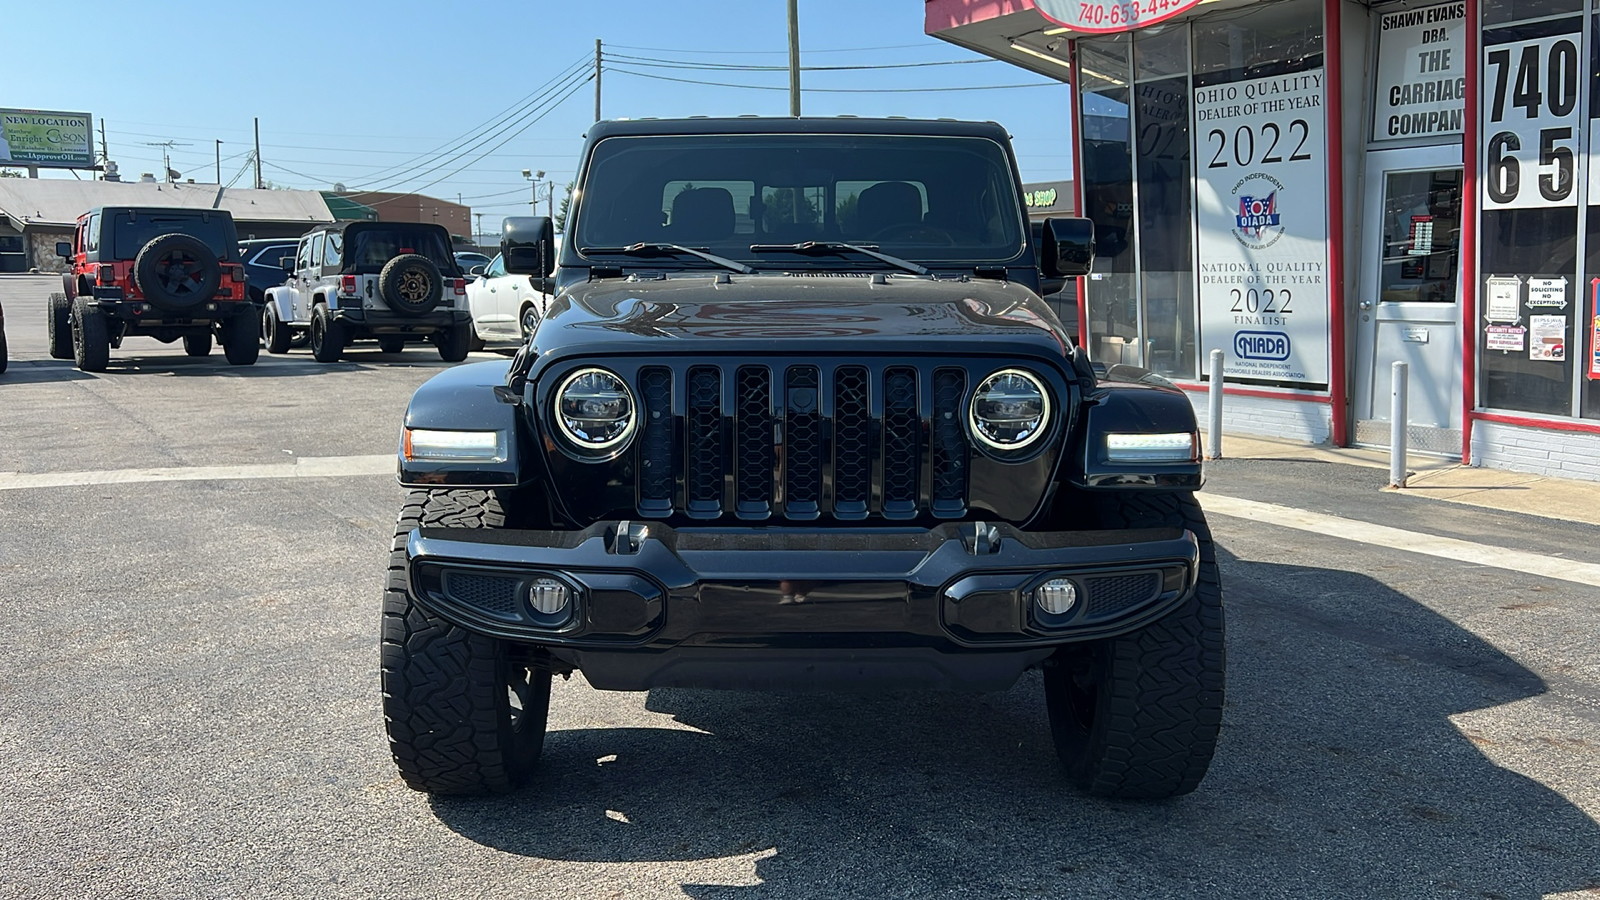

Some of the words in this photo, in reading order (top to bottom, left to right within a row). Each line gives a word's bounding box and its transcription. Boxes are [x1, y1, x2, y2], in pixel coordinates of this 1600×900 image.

[1382, 10, 1424, 31] SHAWN
[1422, 27, 1449, 44] DBA.
[1418, 48, 1451, 73] THE
[1196, 86, 1238, 105] OHIO
[1245, 74, 1322, 99] QUALITY
[1488, 39, 1578, 123] 740
[1198, 104, 1241, 121] DEALER
[1243, 102, 1259, 116] OF
[1261, 99, 1285, 113] THE
[1287, 94, 1320, 110] YEAR
[6, 116, 29, 124] NEW
[32, 117, 85, 127] LOCATION
[1387, 108, 1466, 136] COMPAN
[10, 134, 43, 144] Enright
[1208, 119, 1311, 168] 2022
[1231, 179, 1245, 195] OHIO
[1244, 172, 1285, 192] INDEPENDENT
[1034, 188, 1057, 207] SHOP
[1241, 215, 1273, 227] OIADA
[1201, 262, 1261, 272] NATIONAL
[1267, 262, 1323, 273] QUALITY
[1203, 275, 1243, 284] DEALER
[1247, 275, 1261, 284] OF
[1265, 275, 1287, 284] THE
[1292, 275, 1321, 284] YEAR
[1230, 288, 1293, 314] 2022
[1234, 316, 1288, 326] FINALIST
[1258, 362, 1292, 370] INDEPENDENT
[1272, 370, 1306, 379] ASSOCIATION
